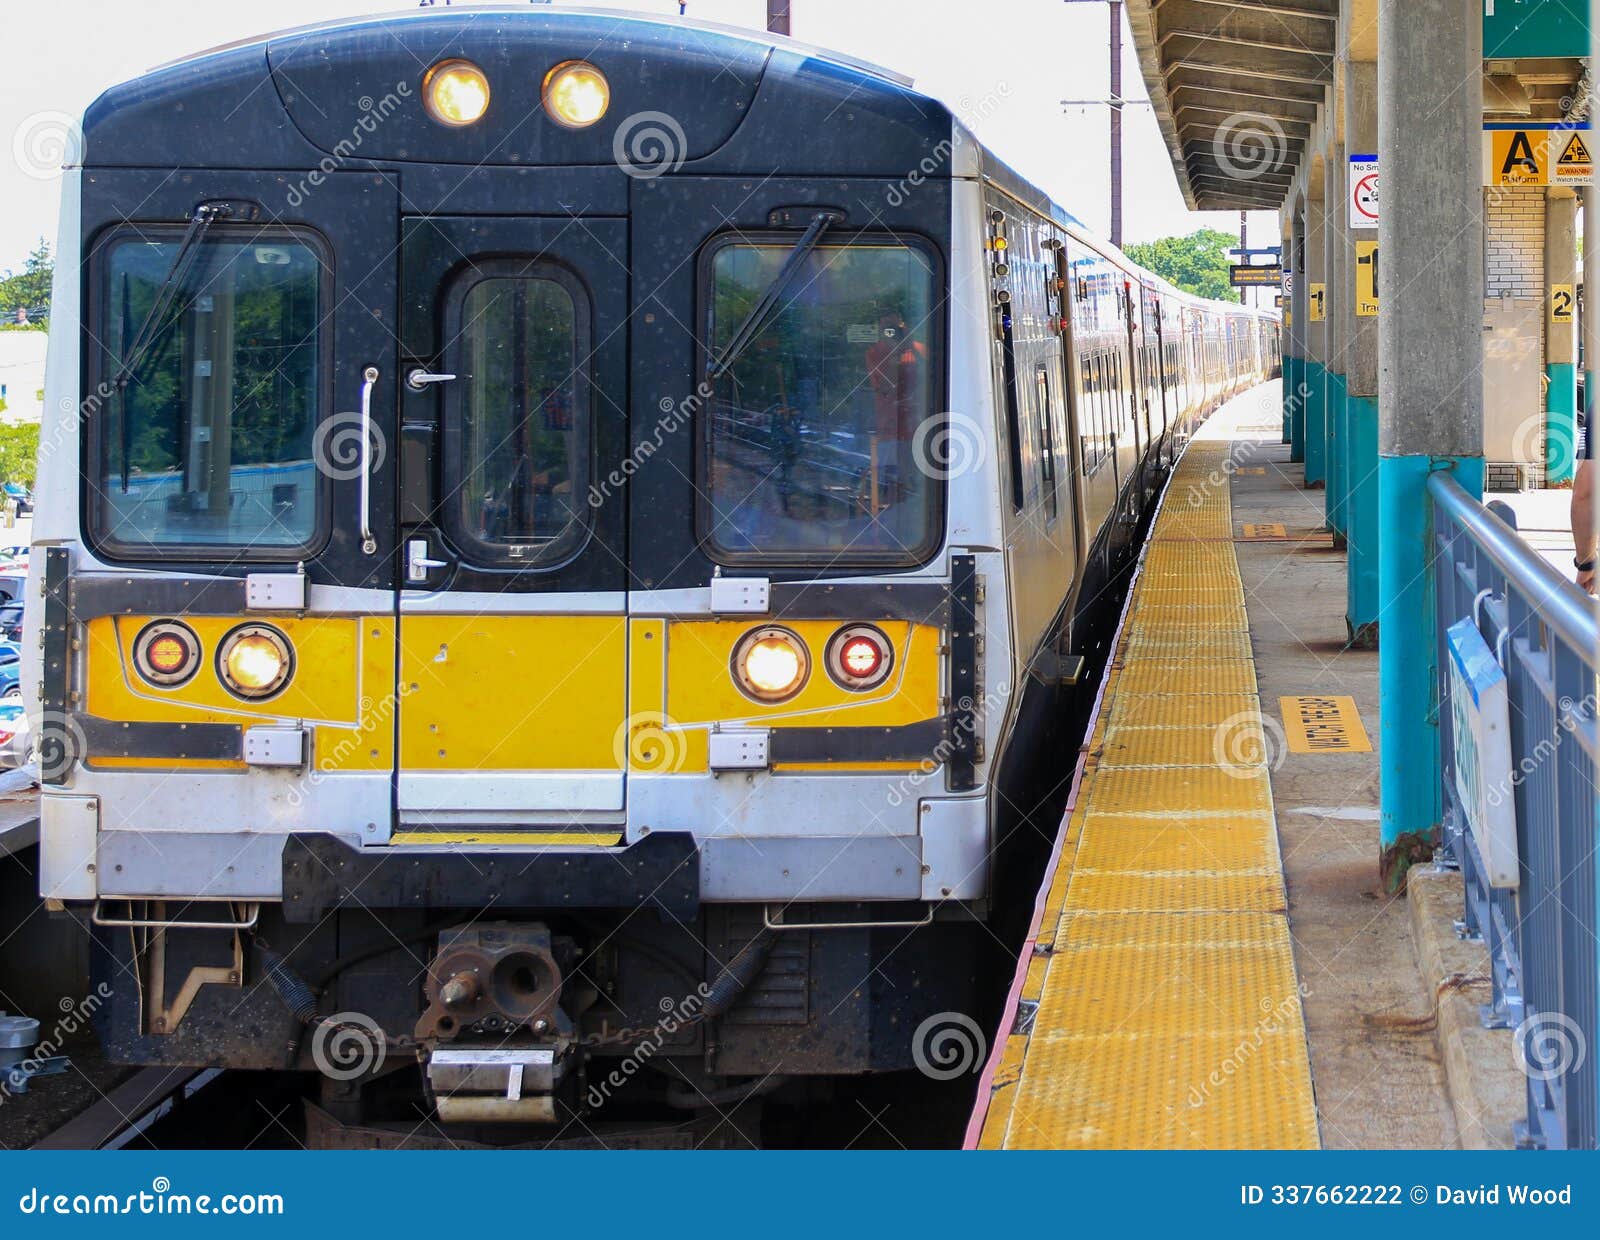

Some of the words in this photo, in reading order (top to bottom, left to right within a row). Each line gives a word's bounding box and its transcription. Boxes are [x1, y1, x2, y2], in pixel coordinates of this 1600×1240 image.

[1502, 132, 1540, 174] A
[1502, 175, 1539, 183] Platform
[1361, 303, 1379, 312] Tra
[1553, 291, 1571, 316] 2
[1298, 697, 1337, 709] GAP
[1302, 710, 1342, 723] THE
[1304, 724, 1351, 749] WATCH
